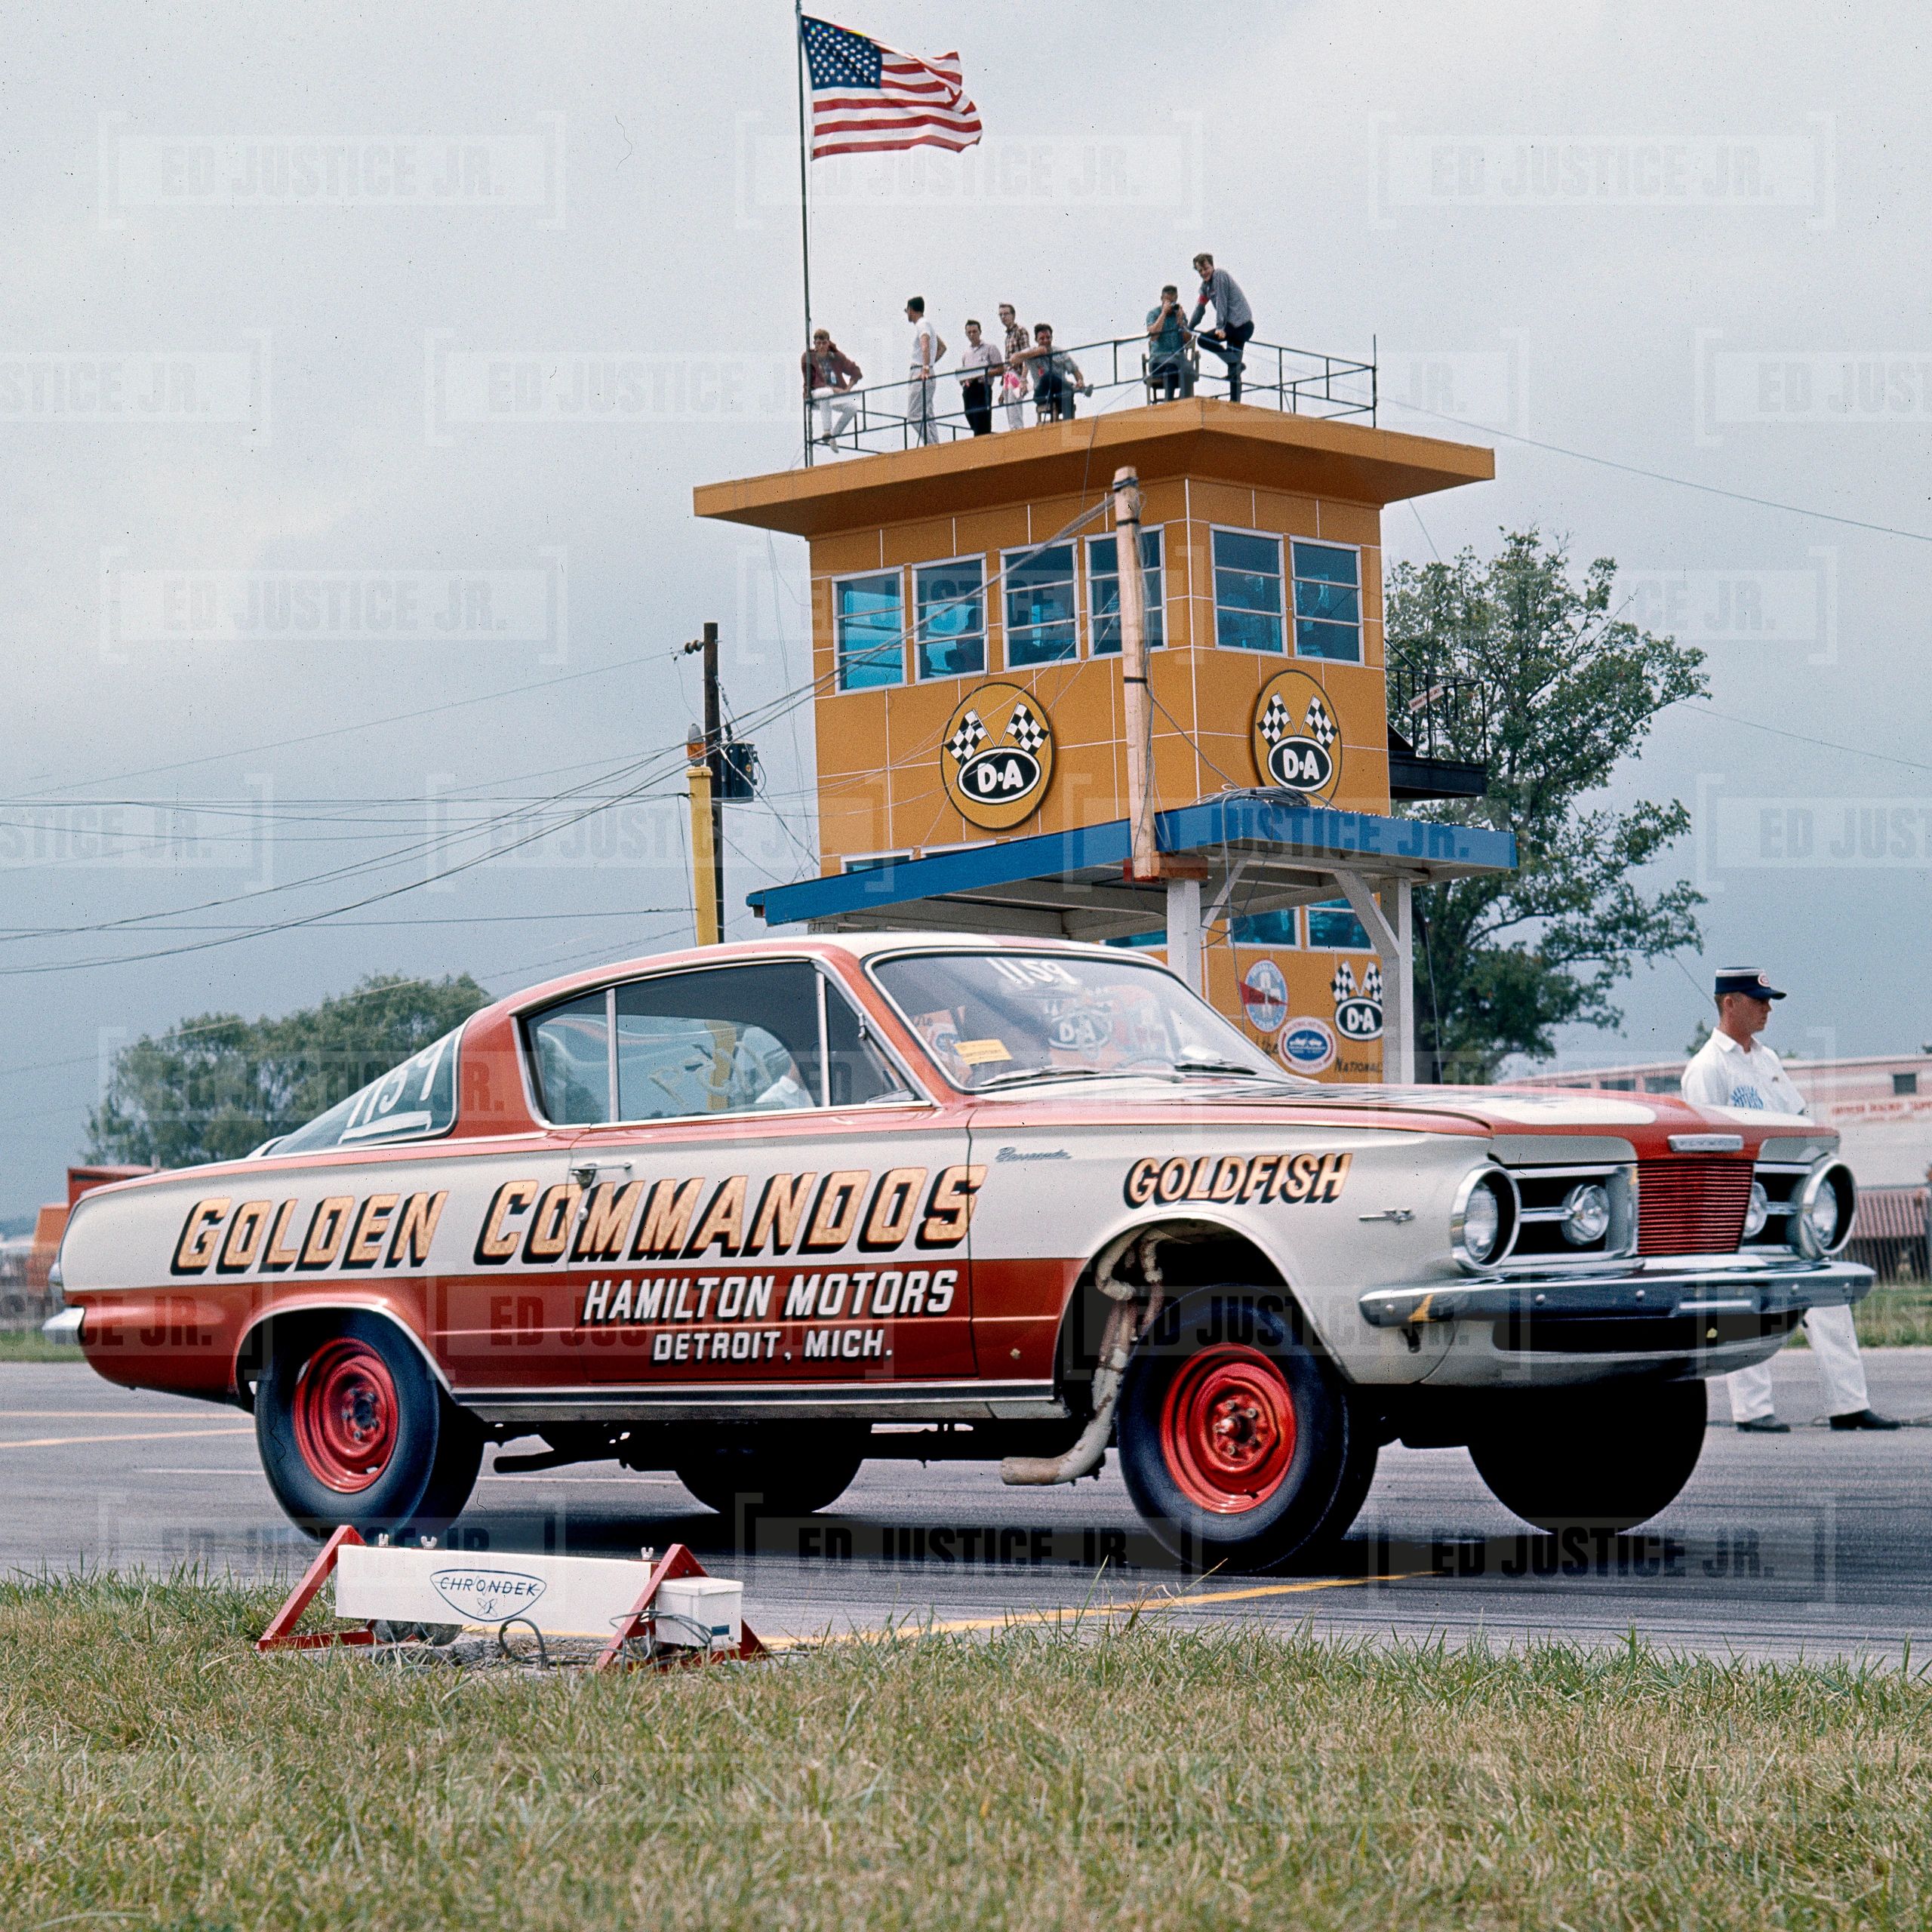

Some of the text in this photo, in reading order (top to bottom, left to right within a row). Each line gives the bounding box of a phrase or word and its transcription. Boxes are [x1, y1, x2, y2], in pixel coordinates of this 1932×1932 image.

[1123, 1152, 1353, 1209] GOLDFISH
[171, 1164, 988, 1275] GOLDEN COMMANDOS
[583, 1269, 959, 1324] HAMILTON MOTORS
[803, 1328, 894, 1363] MICH.
[440, 1577, 538, 1597] CHRONDEK
